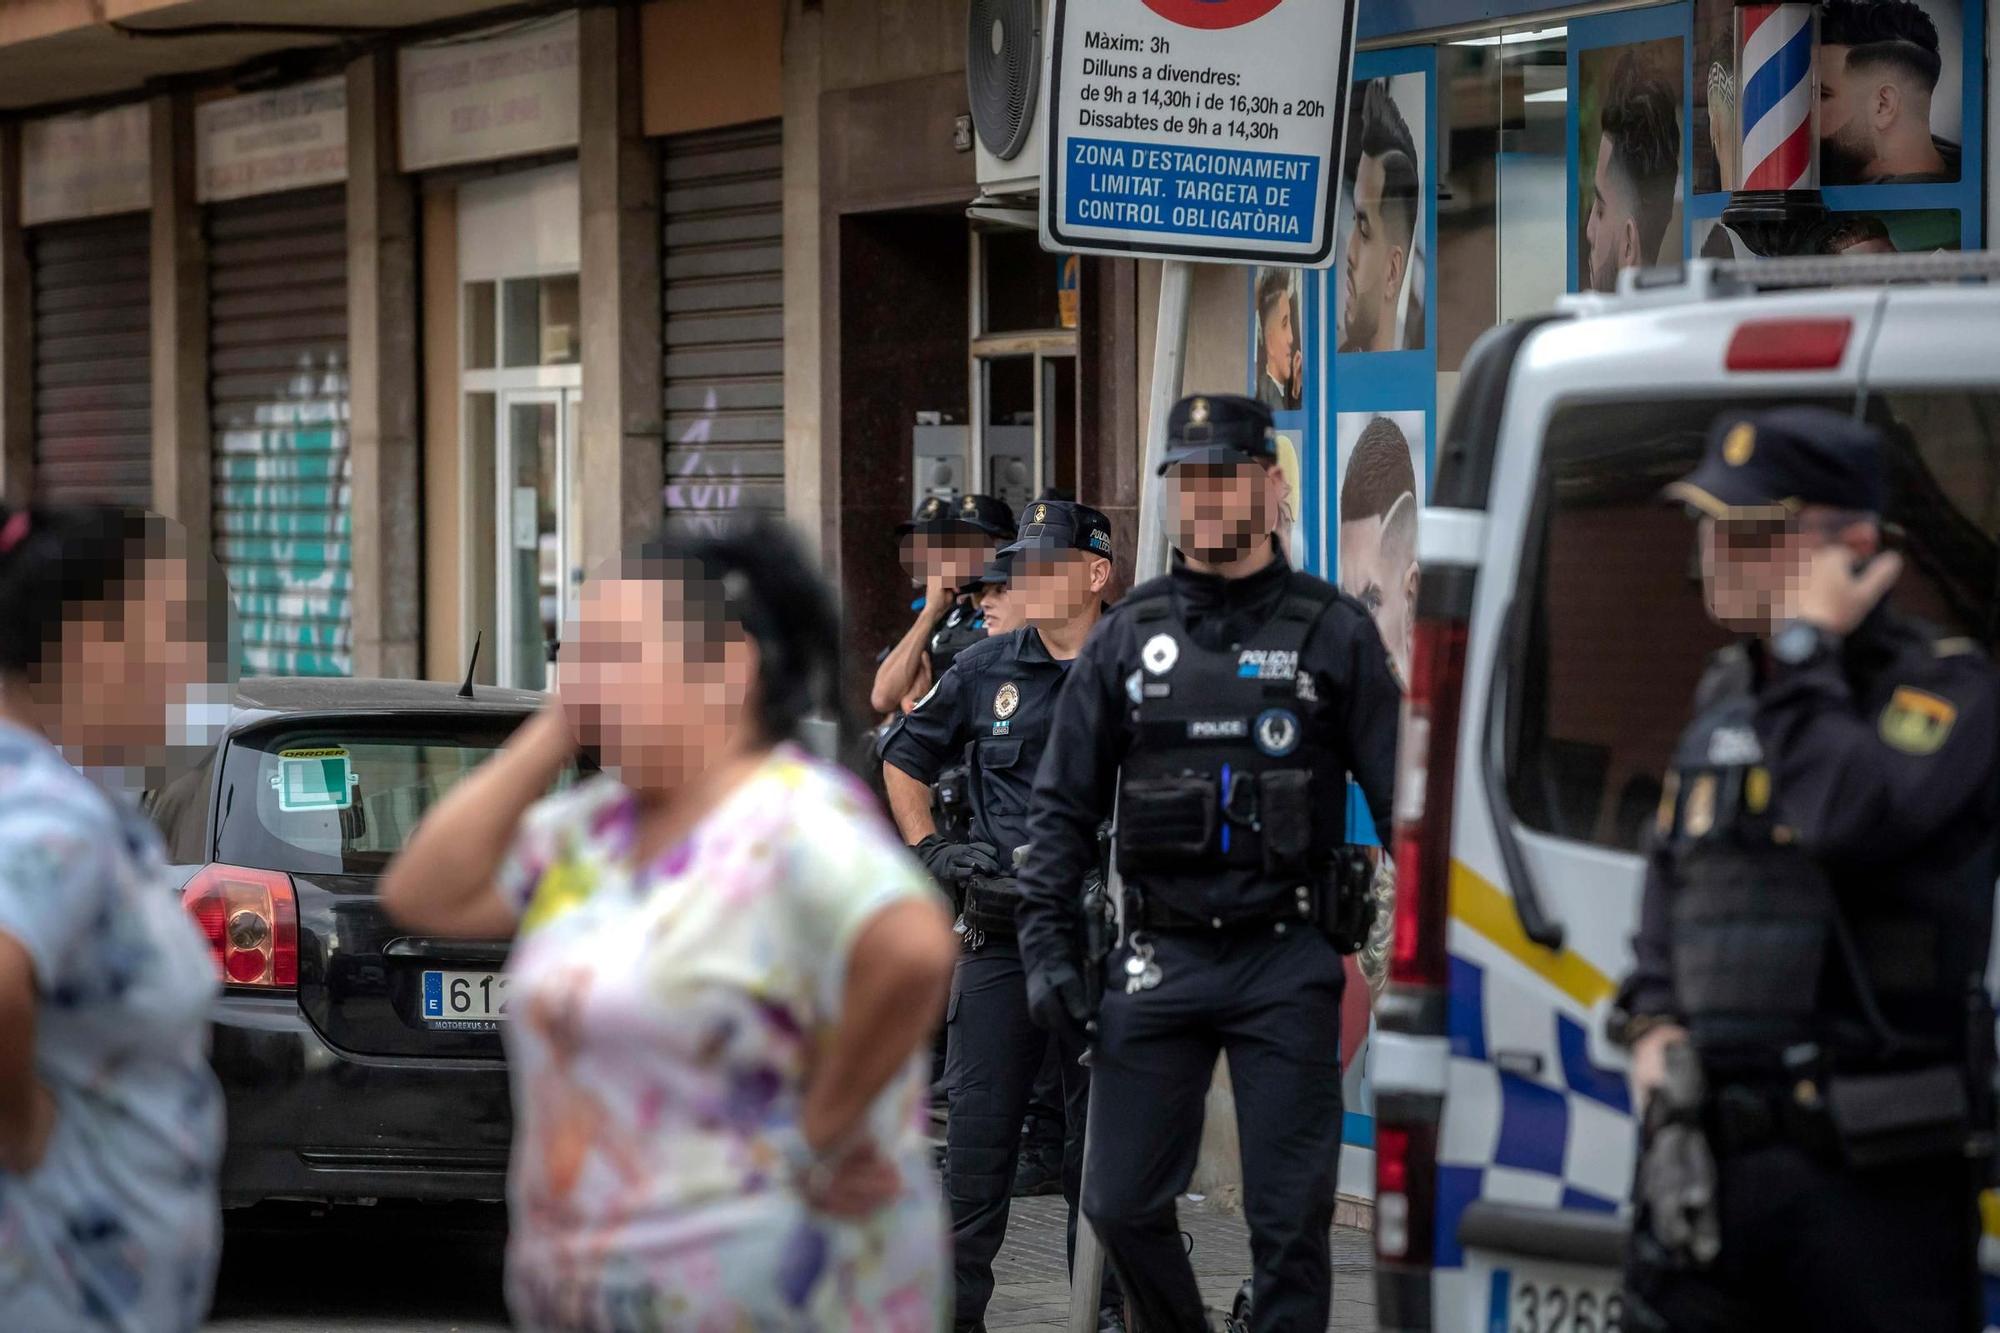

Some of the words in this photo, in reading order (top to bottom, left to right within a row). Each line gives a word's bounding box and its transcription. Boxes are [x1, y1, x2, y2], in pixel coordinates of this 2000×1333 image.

[1084, 31, 1144, 52] Màxim:
[1150, 36, 1170, 54] 3h
[1082, 57, 1138, 79] Dilluns
[1142, 66, 1152, 80] a
[1156, 64, 1241, 86] divendres:
[1080, 84, 1100, 101] de
[1103, 85, 1123, 103] 9h
[1127, 90, 1137, 104] a
[1142, 88, 1191, 110] 14,30h
[1195, 92, 1201, 109] i
[1204, 93, 1224, 110] de
[1229, 95, 1279, 116] 16,30h
[1283, 102, 1293, 116] a
[1296, 99, 1325, 118] 20h
[1079, 108, 1159, 132] Dissabtes
[1163, 115, 1184, 133] de
[1187, 116, 1208, 135] 9h
[1212, 122, 1222, 136] a
[1227, 120, 1279, 141] 14,30h
[1075, 144, 1125, 167] ZONA
[1131, 149, 1311, 182] D'ESTACIONAMENT
[1090, 172, 1166, 198] LIMITAT.
[1175, 179, 1258, 205] TARGETA
[1265, 186, 1291, 207] DE
[1079, 198, 1165, 225] CONTROL
[1172, 206, 1300, 235] OBLIGATÒRIA
[1192, 720, 1241, 735] POLICE
[429, 999, 438, 1010] E
